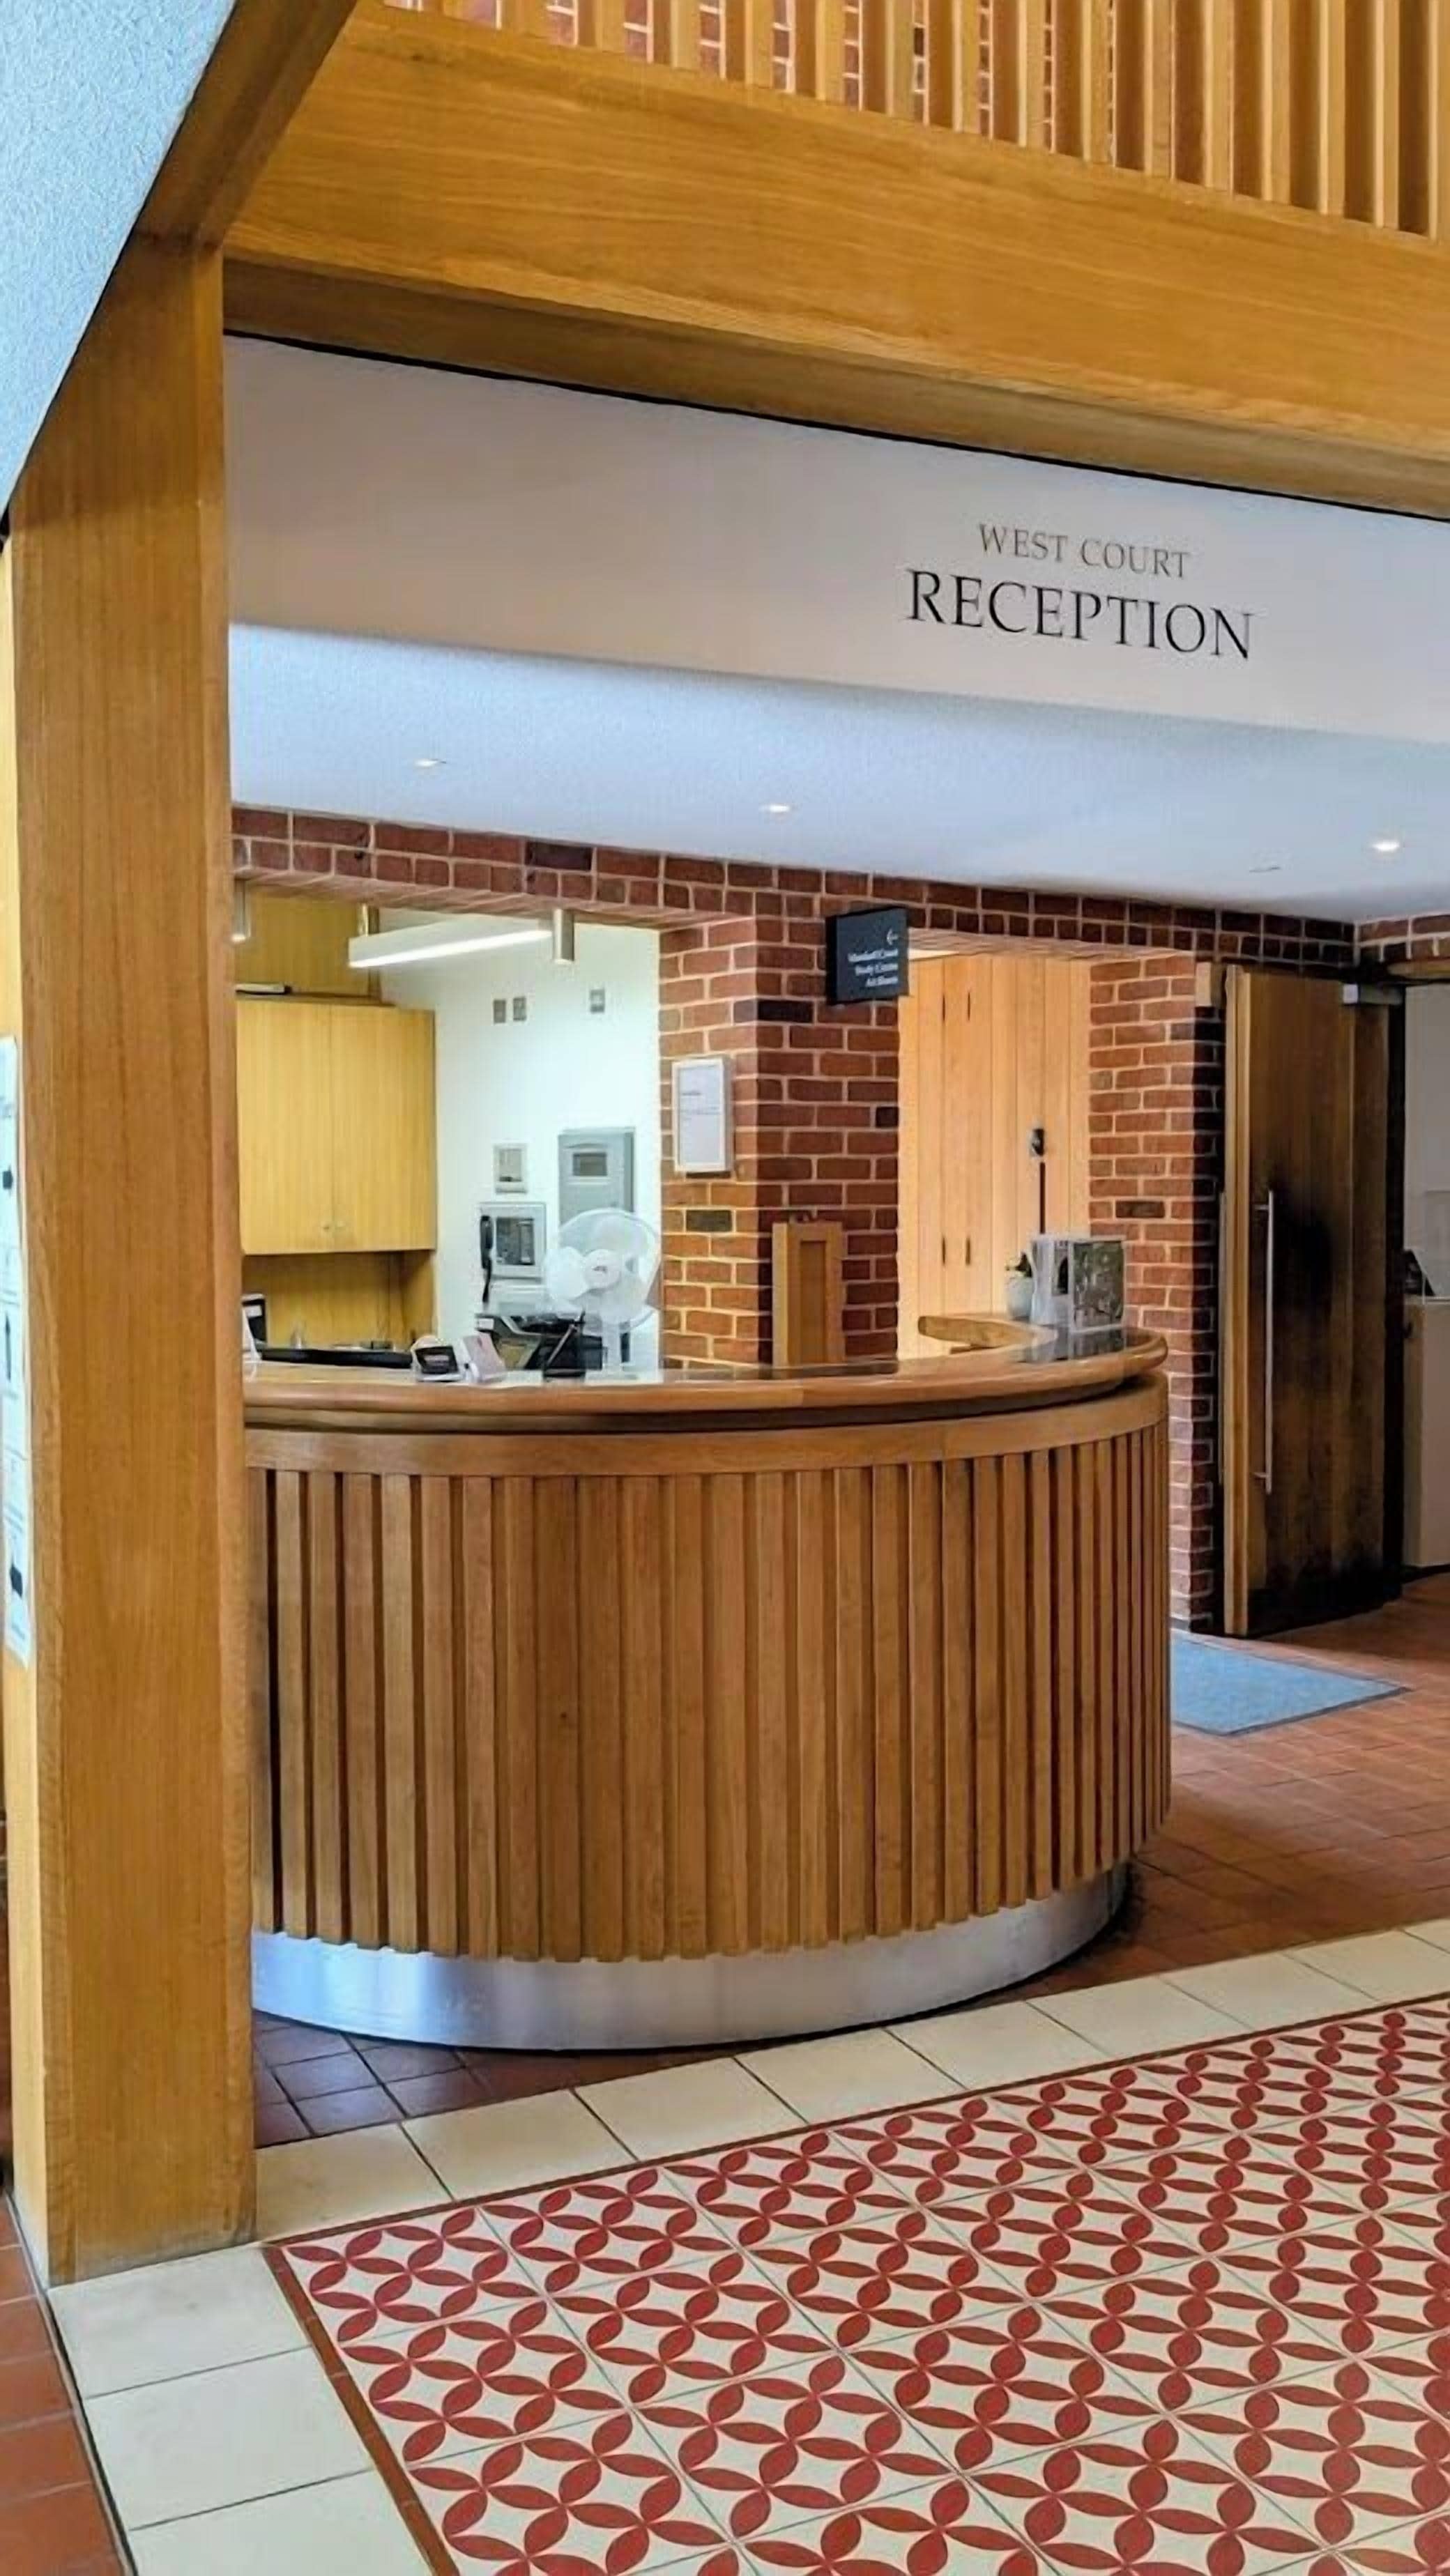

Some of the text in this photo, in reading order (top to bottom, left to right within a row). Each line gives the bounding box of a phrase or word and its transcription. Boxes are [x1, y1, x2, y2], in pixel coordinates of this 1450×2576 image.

[978, 523, 1191, 579] WEST COURT
[906, 567, 1255, 660] RECEPTION
